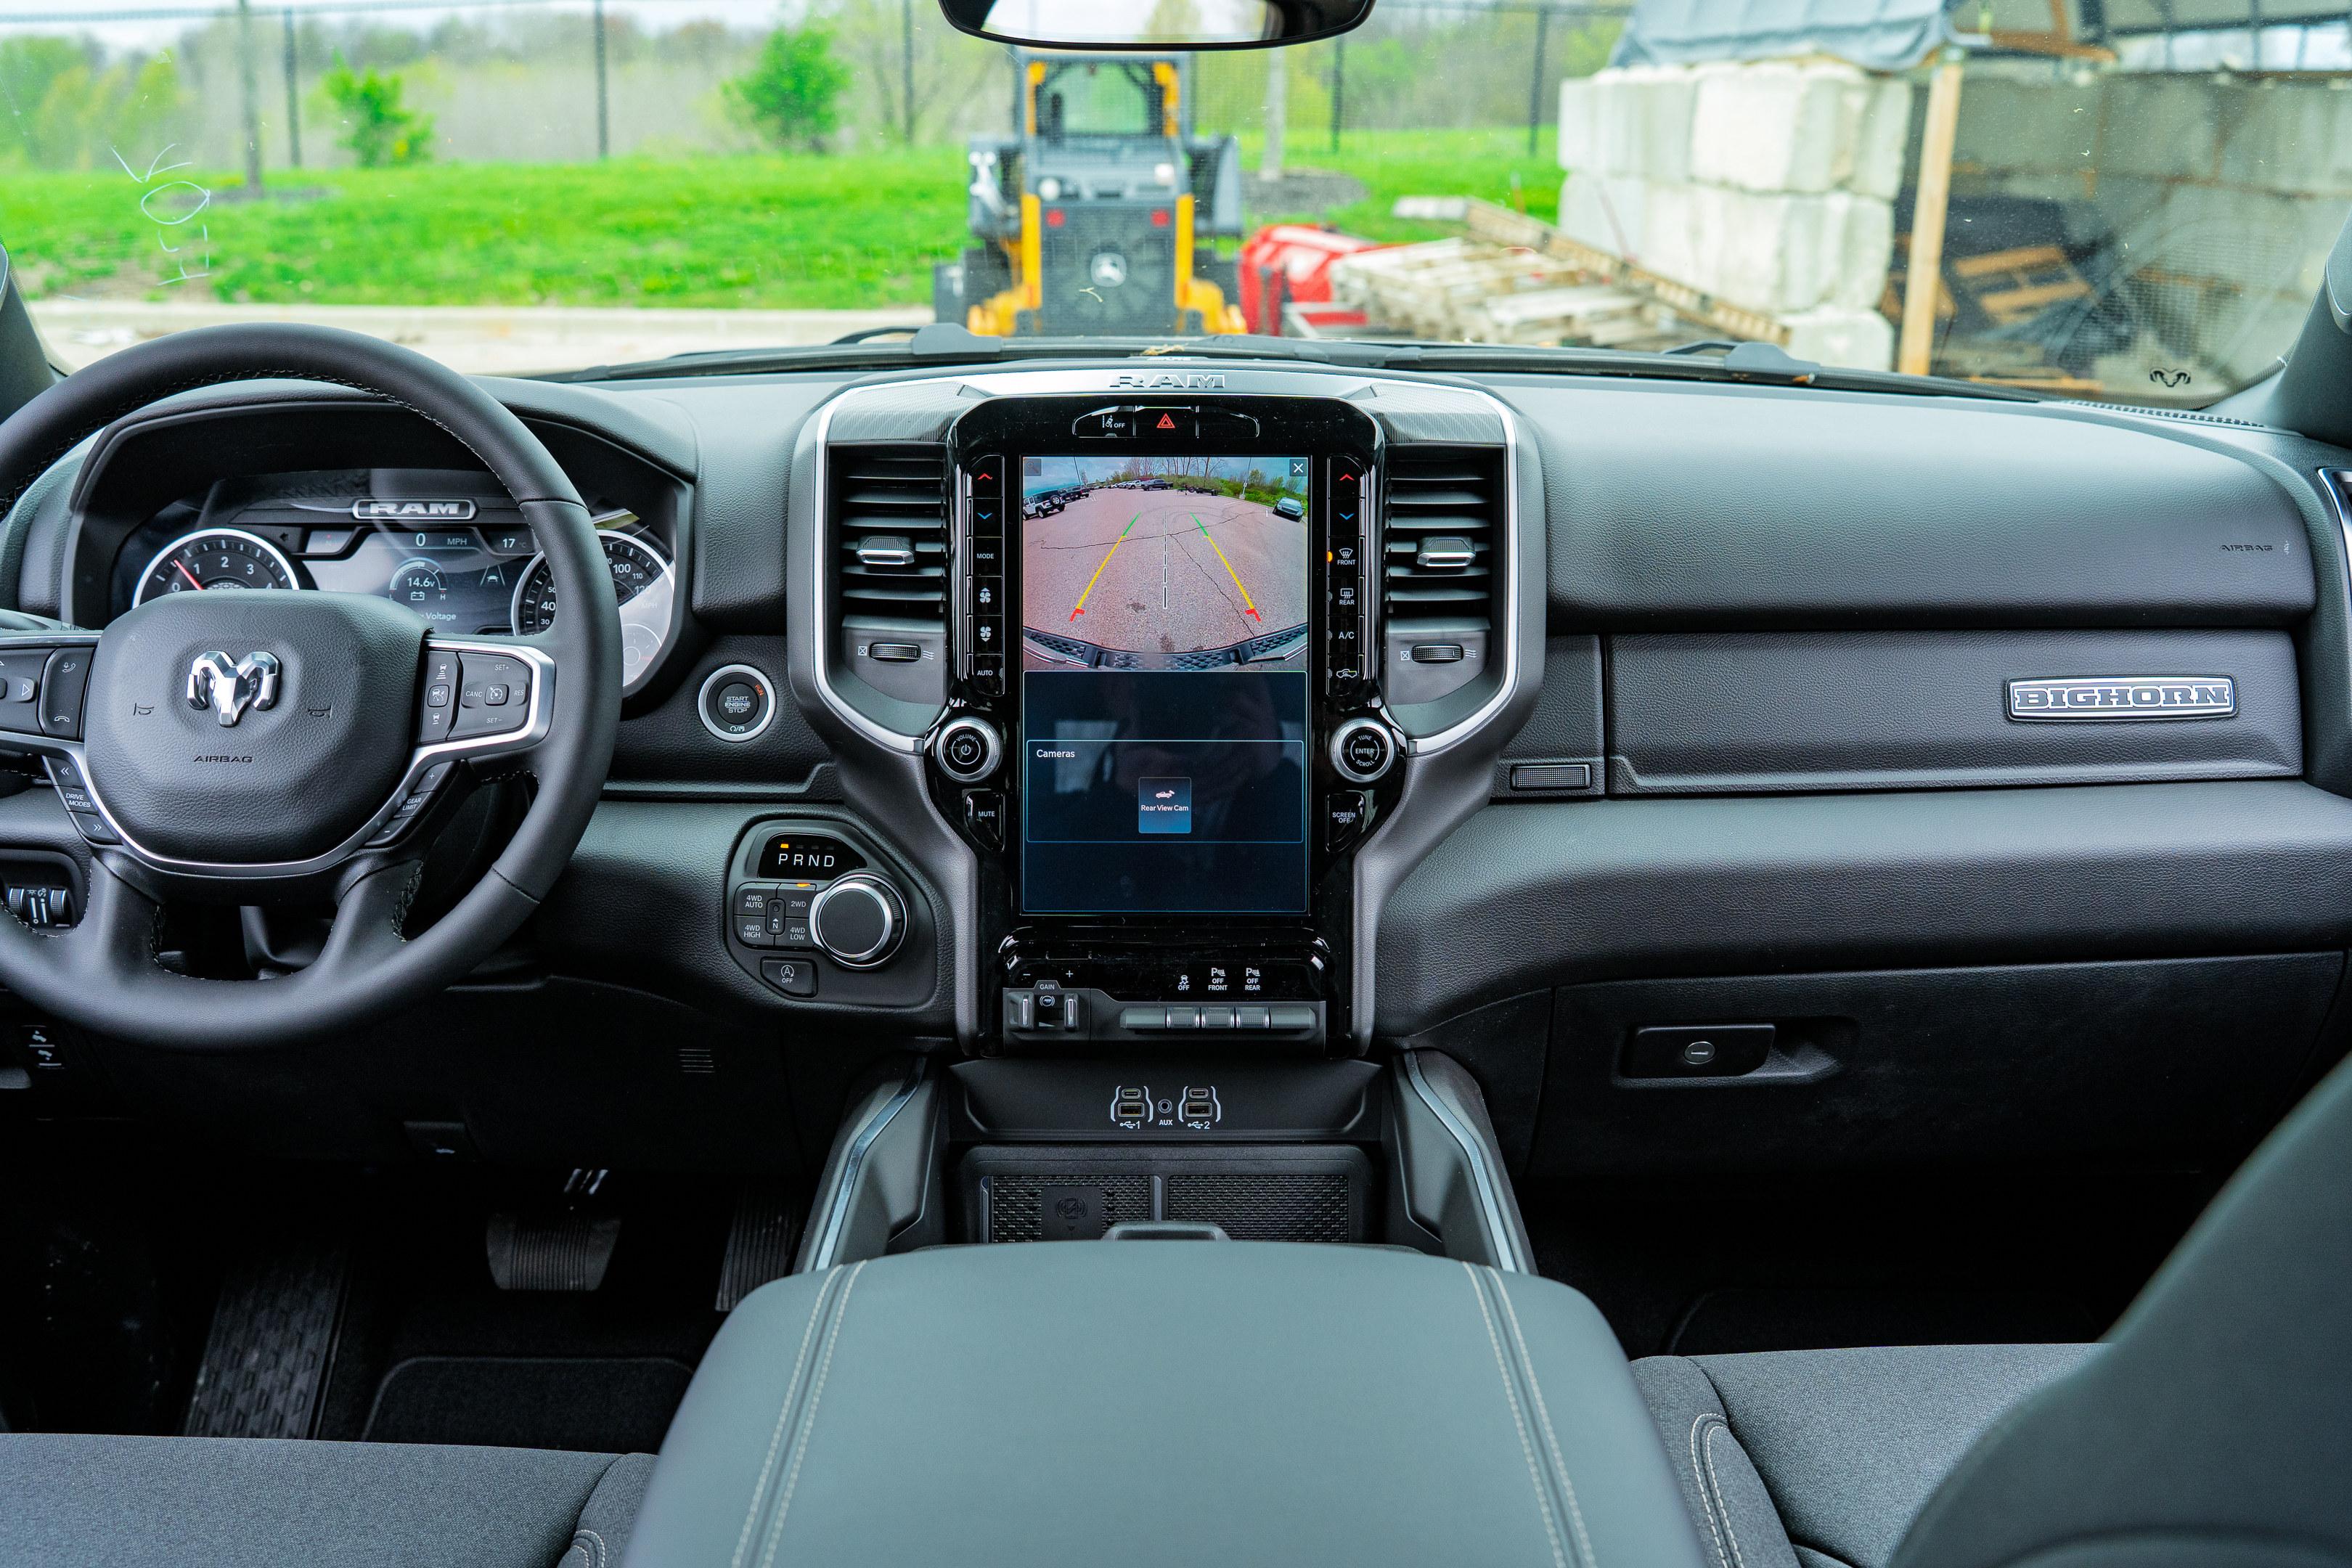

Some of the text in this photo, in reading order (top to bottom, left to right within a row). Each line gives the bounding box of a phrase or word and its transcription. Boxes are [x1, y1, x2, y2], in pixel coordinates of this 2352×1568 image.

[1108, 374, 1225, 388] RAM
[369, 503, 460, 514] RAM
[415, 533, 426, 547] 0
[502, 538, 515, 548] 17
[221, 556, 229, 568] 2
[193, 563, 200, 574] 1
[247, 563, 255, 575] 3
[613, 563, 632, 574] 100
[634, 585, 652, 595] 120
[541, 601, 556, 611] 40
[425, 613, 457, 621] Voltage
[1339, 631, 1355, 640] A/C
[754, 684, 764, 696] RUN
[2014, 685, 2230, 710] BIGHORN
[955, 733, 977, 742] VOLUME
[1036, 749, 1075, 758] Cameras
[1136, 1121, 1140, 1130] 1
[1204, 1121, 1210, 1130] 2
